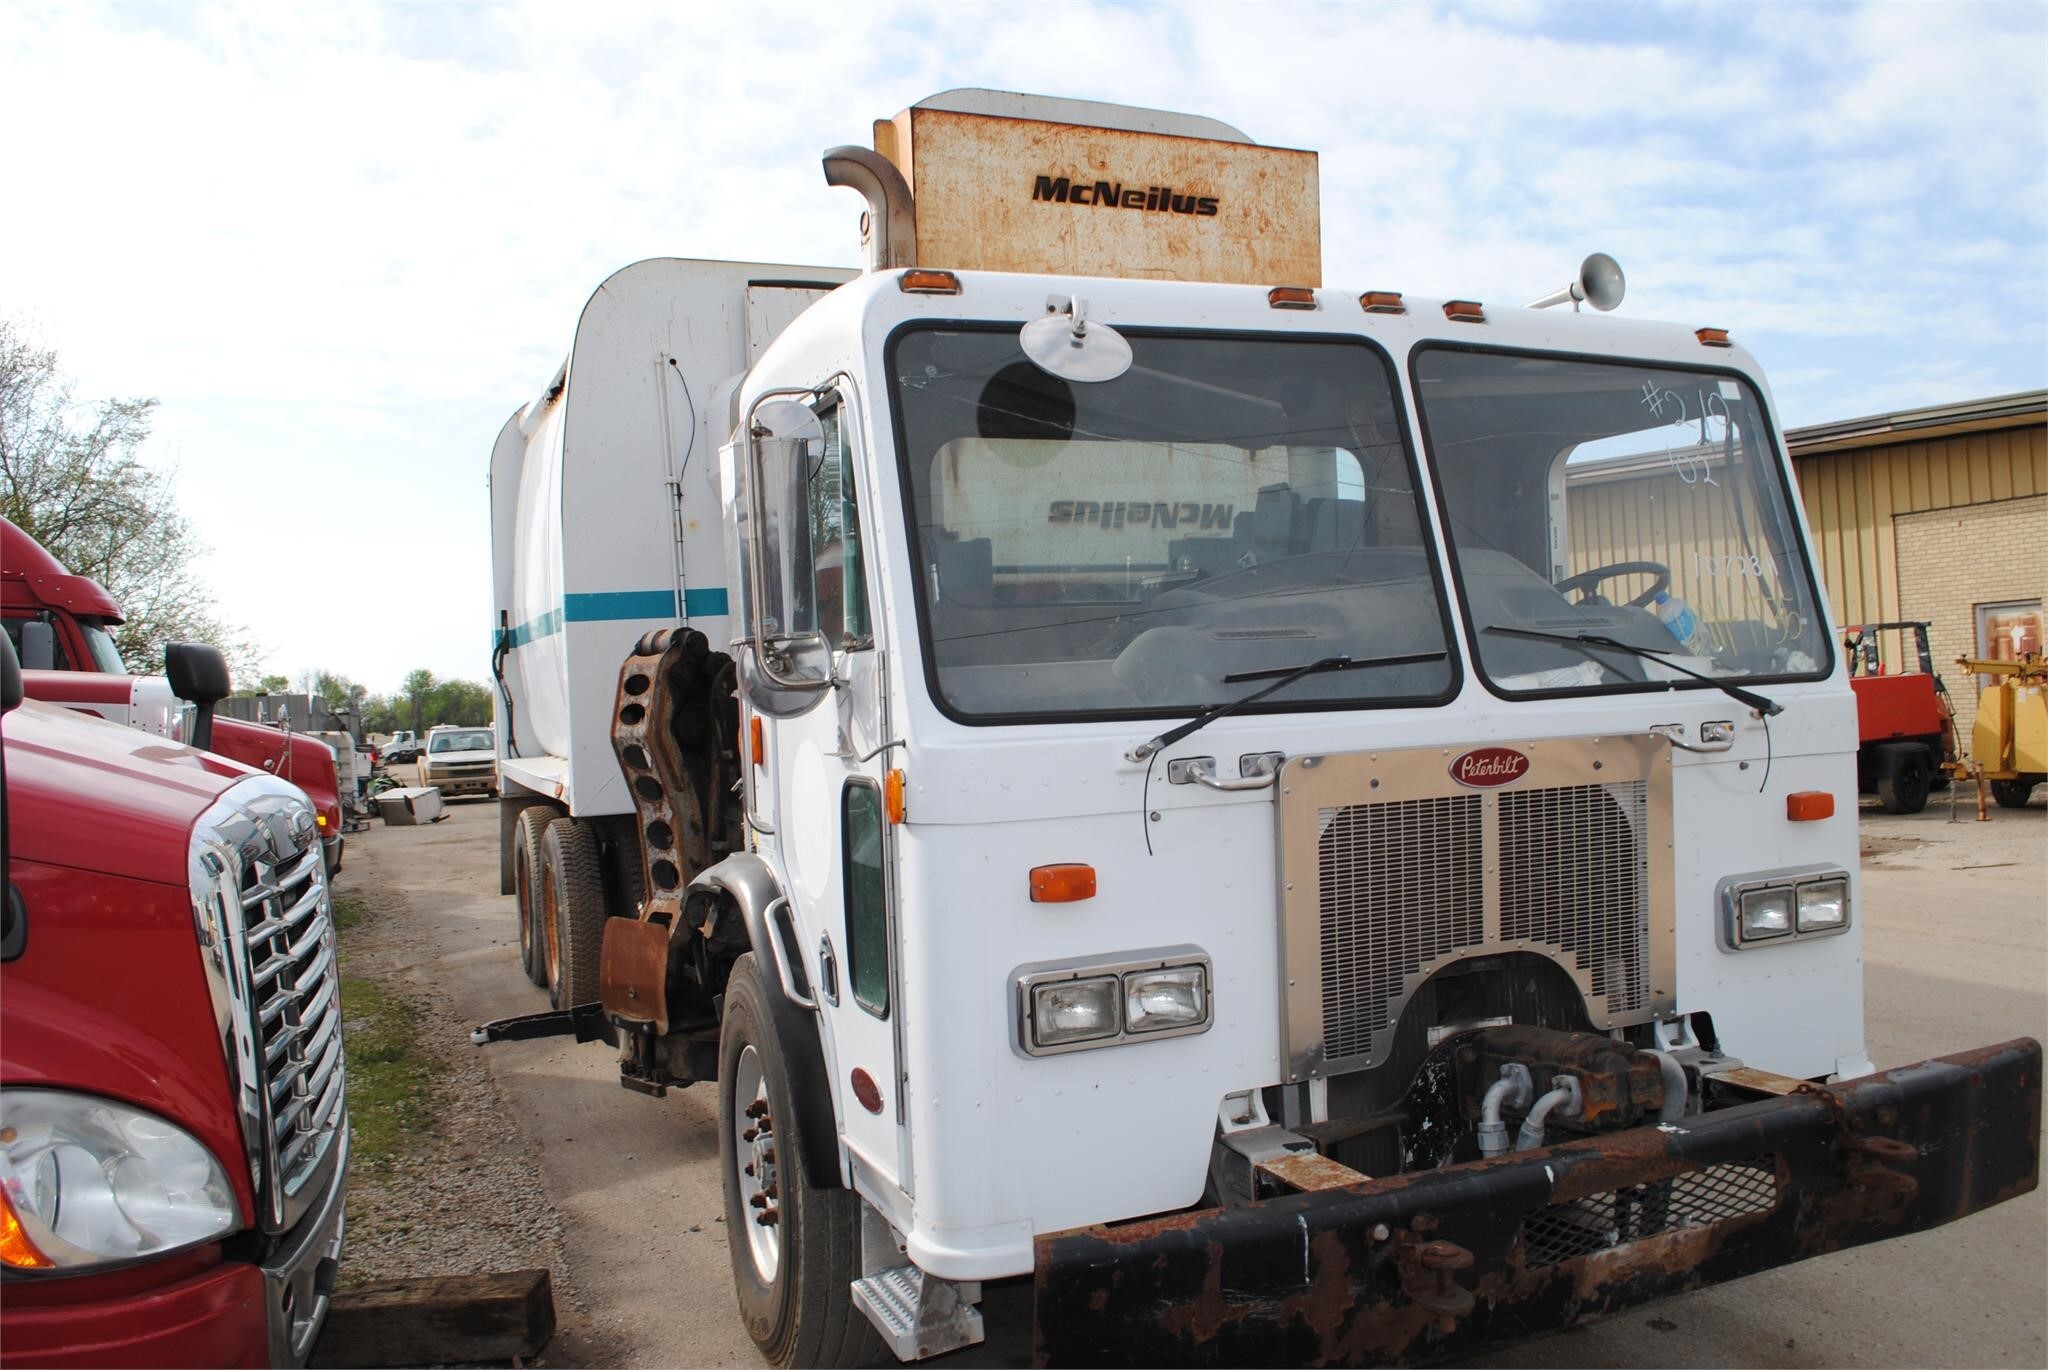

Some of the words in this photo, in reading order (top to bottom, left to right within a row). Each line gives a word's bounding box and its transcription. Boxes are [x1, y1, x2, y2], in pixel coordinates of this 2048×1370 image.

[1032, 175, 1219, 216] McNeilus
[1048, 500, 1233, 529] McNeilus
[1461, 755, 1524, 779] Peterbilt
